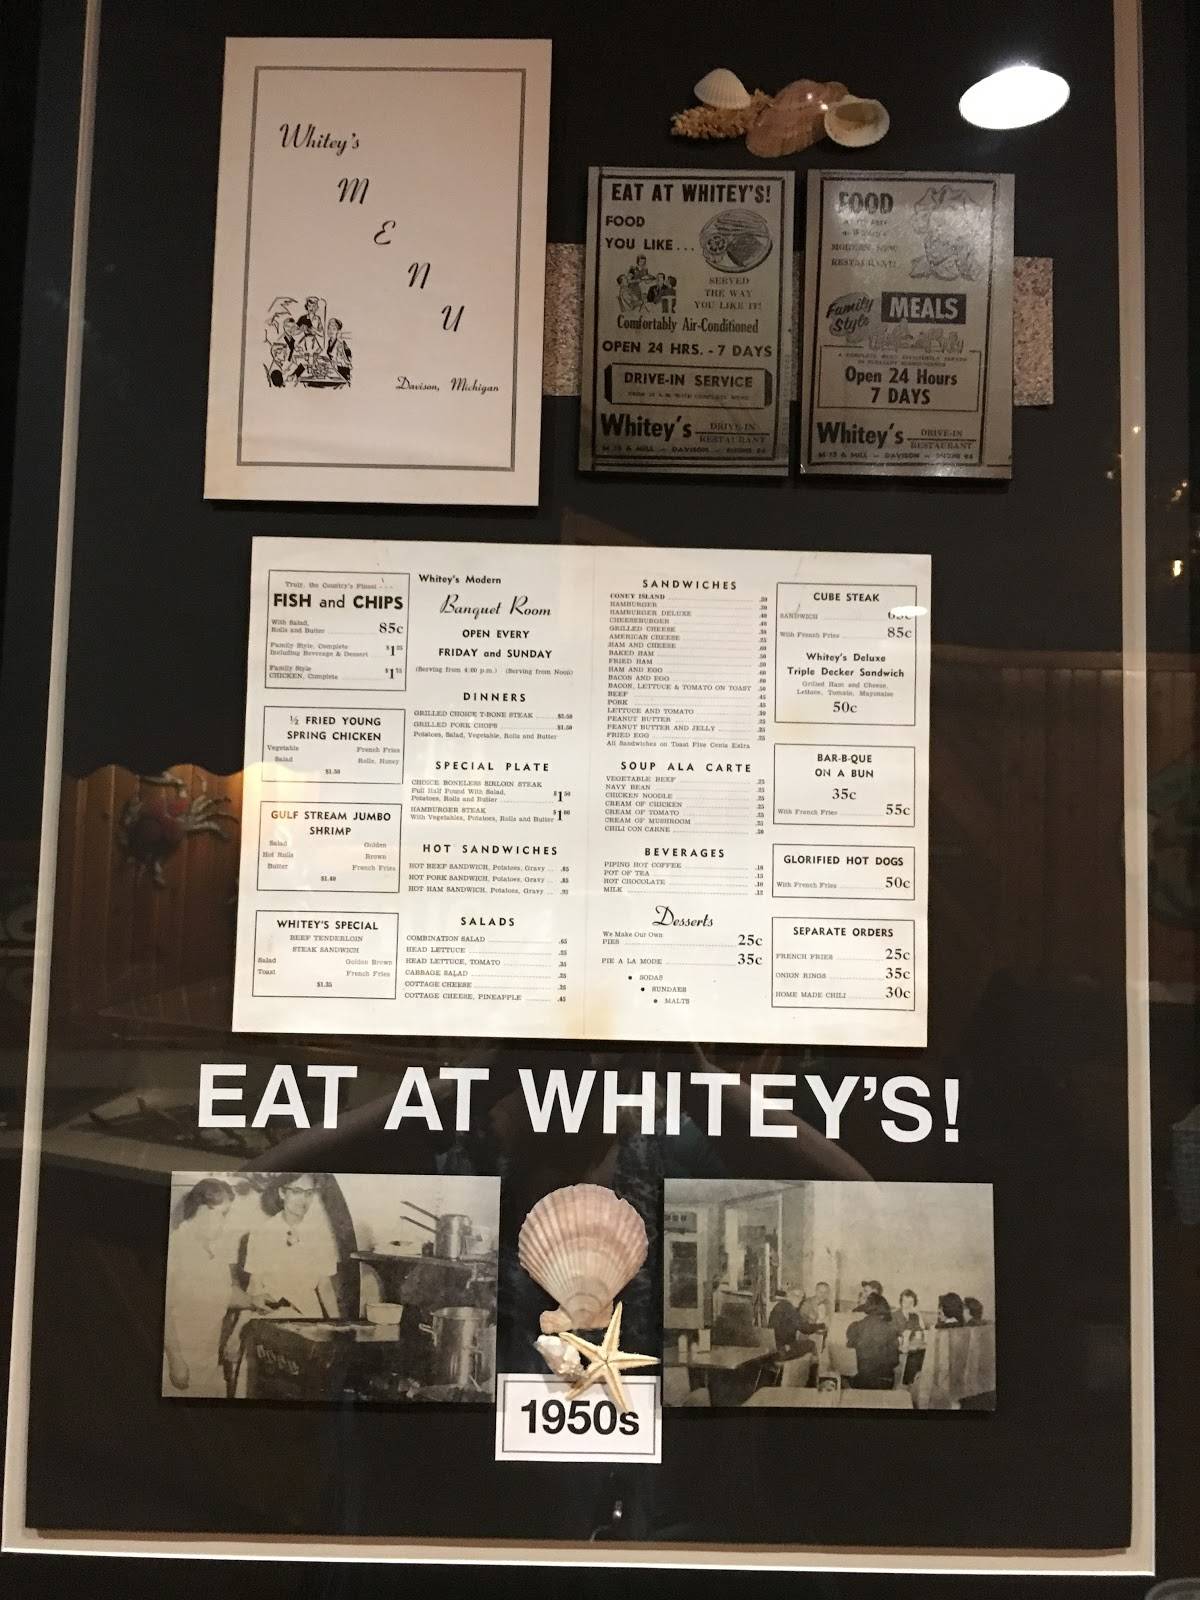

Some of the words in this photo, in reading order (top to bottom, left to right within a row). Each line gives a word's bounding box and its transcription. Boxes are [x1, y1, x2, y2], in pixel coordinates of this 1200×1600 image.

[279, 123, 360, 154] Whitey's
[612, 184, 644, 201] EAT
[652, 184, 674, 202] AT
[682, 184, 771, 203] WHITEY'S!
[838, 191, 894, 213] FOOD
[606, 216, 645, 227] FOOD
[374, 220, 396, 245] E
[606, 238, 636, 250] YOU
[826, 297, 873, 318] Family
[889, 297, 958, 319] MEALS
[617, 316, 677, 332] Comfortably
[682, 318, 758, 334] Air-Conditioned
[602, 341, 640, 352] OPEN
[648, 342, 664, 354] 24
[671, 344, 703, 356] HRS.
[718, 346, 725, 356] 7
[732, 346, 772, 357] DAYS
[624, 372, 686, 386] DRIVE-IN
[695, 376, 752, 388] SERVICE
[845, 368, 882, 384] Open
[889, 367, 909, 383] 24
[917, 368, 957, 385] Hours
[396, 376, 440, 391] Davison,
[450, 377, 499, 394] Michigan
[871, 388, 880, 403] 7
[888, 388, 930, 404] DAYS
[601, 413, 692, 442] Whitey's
[817, 422, 903, 448] Whitey's
[419, 574, 460, 585] Whitey's
[465, 576, 501, 584] Modern
[643, 580, 737, 590] SANDWICHES
[274, 594, 311, 607] FISH
[320, 594, 345, 608] and
[353, 596, 403, 609] CHIPS
[814, 593, 840, 601] CUBE
[846, 593, 880, 602] STEAK
[440, 594, 502, 620] Banquet
[510, 596, 552, 616] Room
[379, 622, 404, 634] 85c
[888, 627, 912, 638] 85c
[497, 630, 530, 638] EVERY
[439, 648, 478, 657] FRIDAY
[507, 650, 552, 658] SUNDAY
[806, 652, 847, 663] Whitey's
[854, 654, 886, 662] Deluxe
[788, 667, 815, 677] Triple
[822, 668, 854, 676] Decker
[860, 668, 904, 677] Sandwich
[464, 693, 526, 702] DINNERS
[833, 702, 857, 713] 50c
[306, 717, 336, 725] FRIED
[342, 717, 381, 726] YOUNG
[288, 731, 326, 740] SPRING
[332, 732, 381, 741] CHICKEN
[817, 754, 872, 764] BAR-B-QUE
[436, 762, 494, 770] SPECIAL
[506, 763, 549, 771] PLATE
[621, 762, 656, 770] SOUP
[668, 763, 694, 771] ALA
[706, 764, 751, 772] CARTE
[815, 769, 831, 777] ON
[832, 788, 856, 800] 35c
[886, 804, 910, 815] 55c
[271, 811, 298, 819] GULF
[304, 811, 347, 820] STREAM
[353, 812, 391, 821] JUMBO
[310, 827, 352, 835] SHRIMP
[423, 844, 451, 853] HOT
[463, 845, 557, 855] SANDWICHES
[645, 848, 725, 857] BEVERAGES
[784, 855, 840, 864] GLORIFIED
[847, 857, 869, 865] HOT
[875, 857, 903, 865] DOGS
[885, 877, 910, 888] 50c
[461, 917, 515, 926] SALADS
[652, 905, 714, 927] Desserts
[277, 920, 329, 929] WHITEY'S
[335, 921, 378, 930] SPECIAL
[793, 927, 846, 936] SEPARATE
[853, 928, 893, 937] ORDERS
[738, 935, 762, 946] 25c
[738, 954, 762, 965] 35c
[885, 949, 911, 960] 25c
[885, 968, 911, 979] 35c
[886, 987, 911, 998] 30c
[197, 1064, 357, 1129] EAT
[385, 1067, 490, 1132] AT
[520, 1068, 964, 1142] WHITEY'S!
[520, 1399, 639, 1438] 1950s
